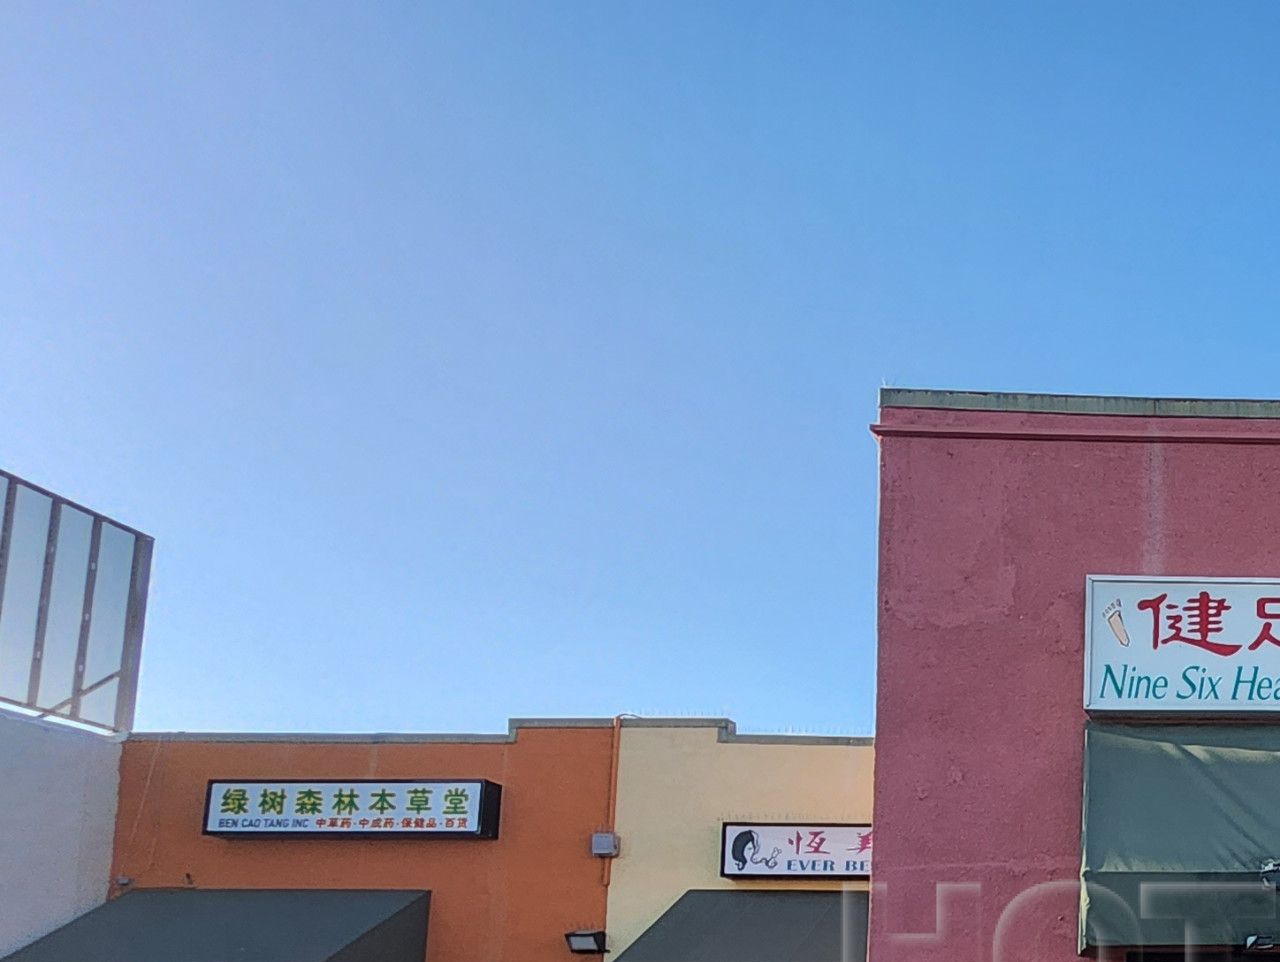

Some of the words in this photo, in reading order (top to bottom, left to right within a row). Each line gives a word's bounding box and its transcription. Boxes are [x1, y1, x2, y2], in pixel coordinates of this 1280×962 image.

[1099, 663, 1168, 700] Nine
[1176, 665, 1222, 700] Six
[220, 788, 470, 816] 绿树森林本草堂
[218, 818, 239, 828] BEN
[241, 818, 261, 828] CAO
[263, 818, 290, 828] TANG
[291, 818, 309, 828] INC
[787, 860, 835, 872] EVER
